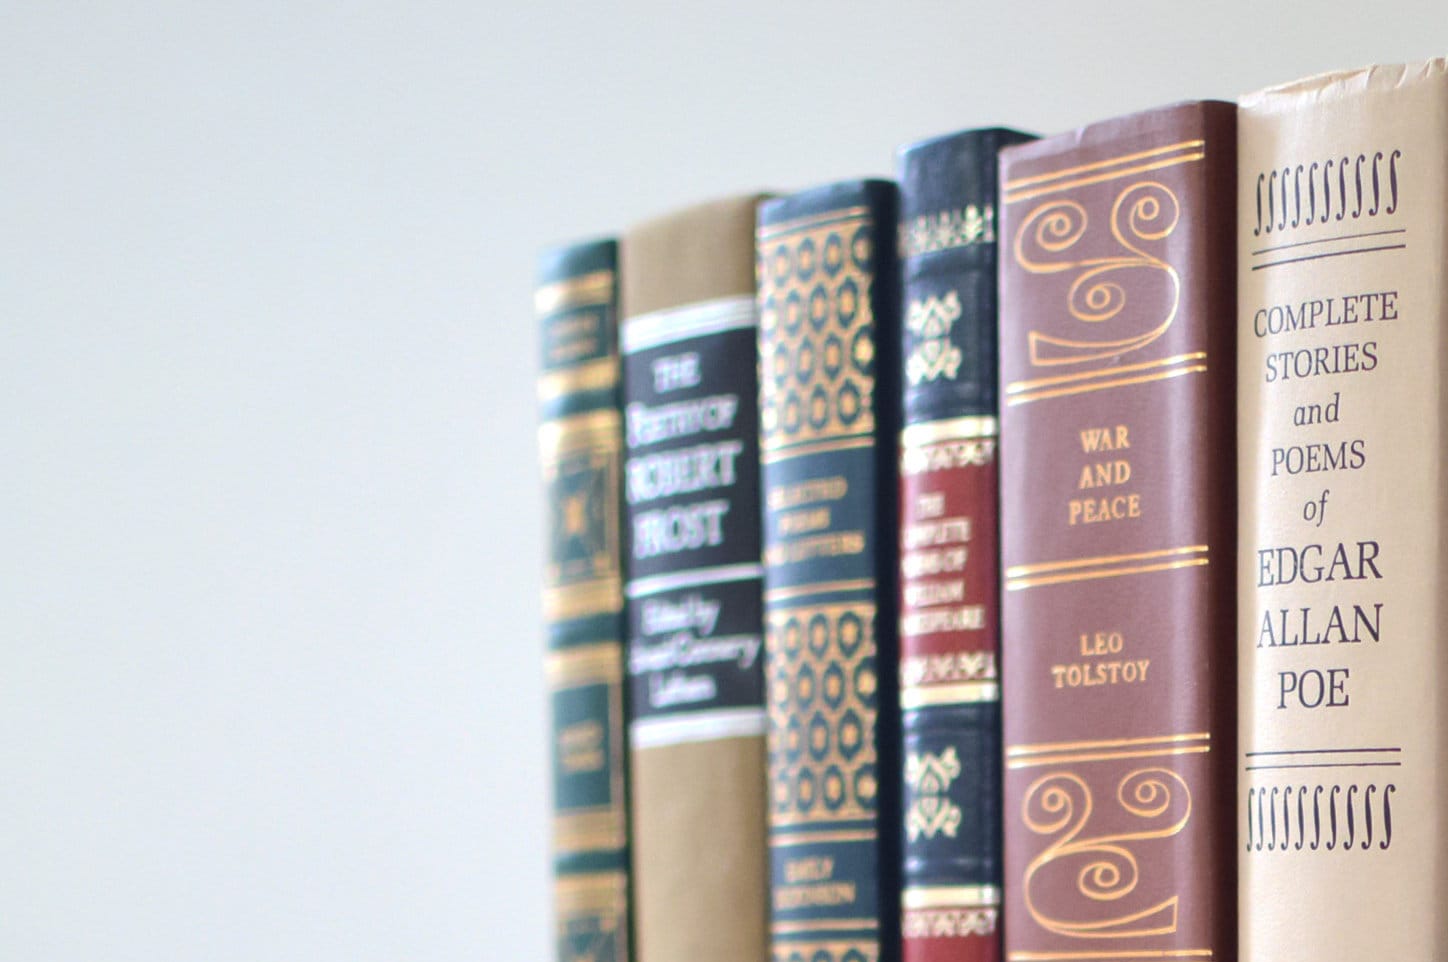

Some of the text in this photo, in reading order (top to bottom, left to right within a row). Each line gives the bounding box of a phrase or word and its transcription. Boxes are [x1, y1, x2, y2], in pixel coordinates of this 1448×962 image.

[1253, 291, 1399, 338] COMPLETE
[1265, 342, 1379, 383] STORIES
[1293, 392, 1341, 427] and
[1079, 425, 1131, 453] WAR
[1079, 460, 1132, 490] AND
[1271, 440, 1367, 477] POEMS
[1068, 494, 1142, 526] PEACE
[1302, 489, 1330, 527] of
[1256, 540, 1384, 588] EDGAR
[1079, 633, 1124, 656] LEO
[1256, 604, 1384, 648] ALLAN
[1051, 659, 1150, 689] TOLSTOY
[1276, 668, 1350, 709] POE
